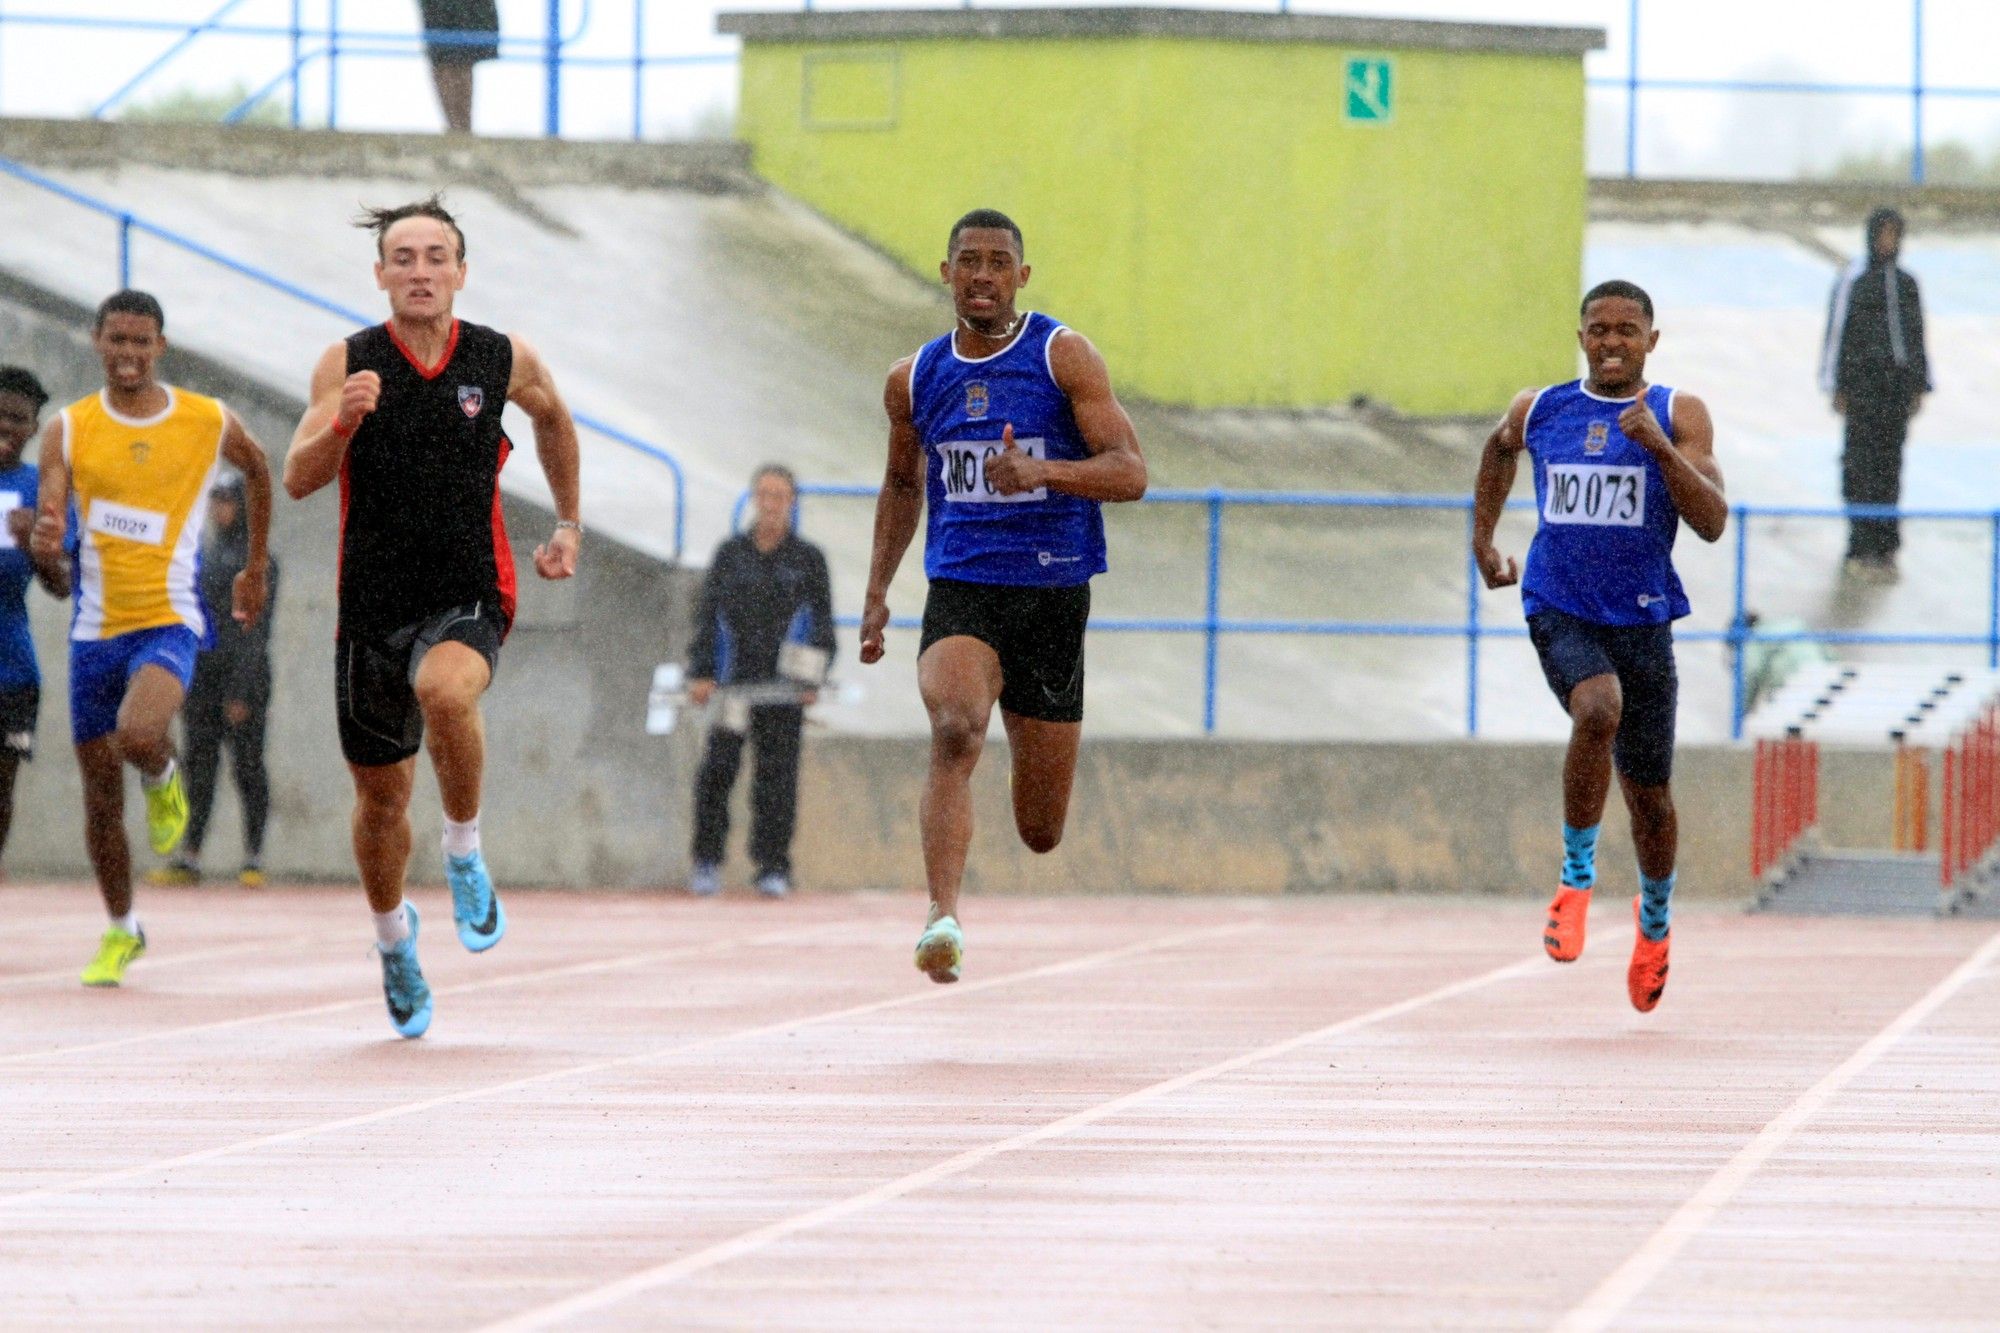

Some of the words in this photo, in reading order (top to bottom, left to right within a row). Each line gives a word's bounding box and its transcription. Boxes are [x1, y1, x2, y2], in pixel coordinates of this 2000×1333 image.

[947, 449, 976, 493] MO
[1551, 472, 1580, 514] MO
[1585, 472, 1637, 519] 073
